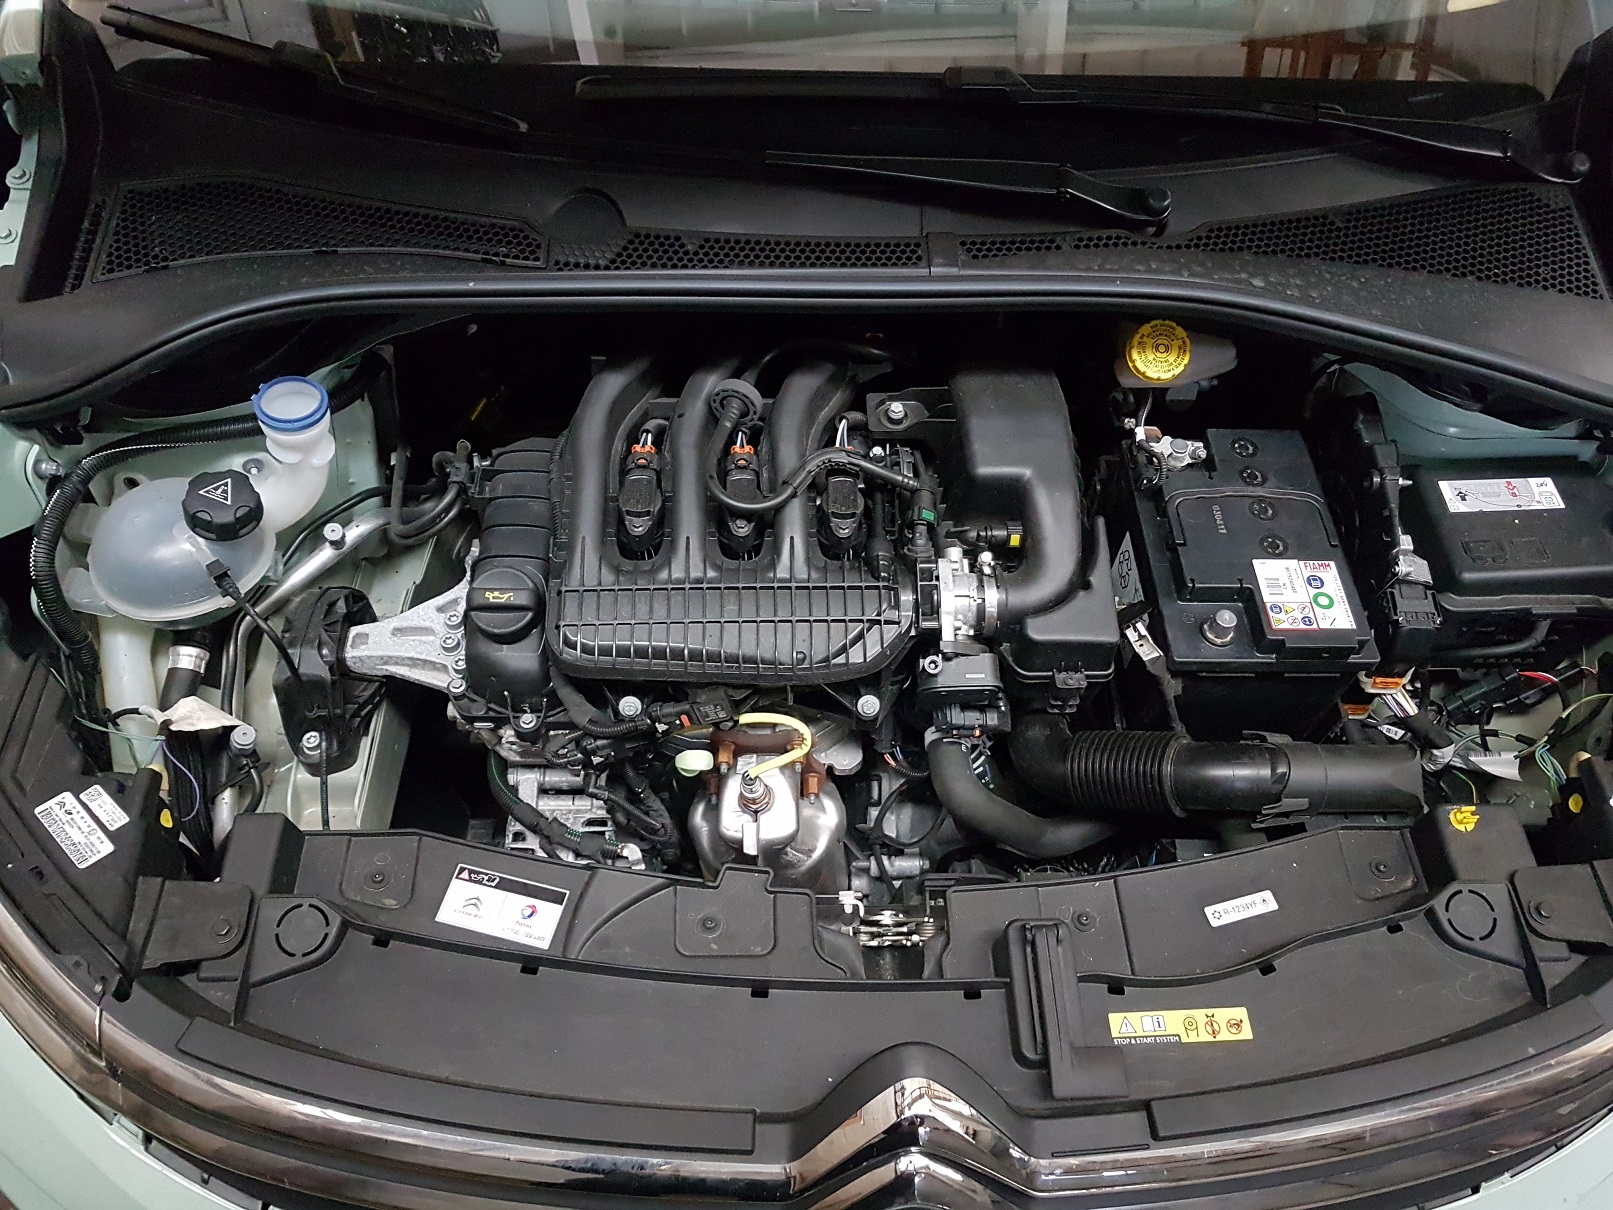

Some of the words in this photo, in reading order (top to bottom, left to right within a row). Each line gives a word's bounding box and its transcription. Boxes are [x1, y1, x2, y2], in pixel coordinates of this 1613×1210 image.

[1303, 561, 1332, 571] FIAMM
[1222, 900, 1258, 915] R-1234YF
[1156, 1035, 1179, 1043] SYSTEM
